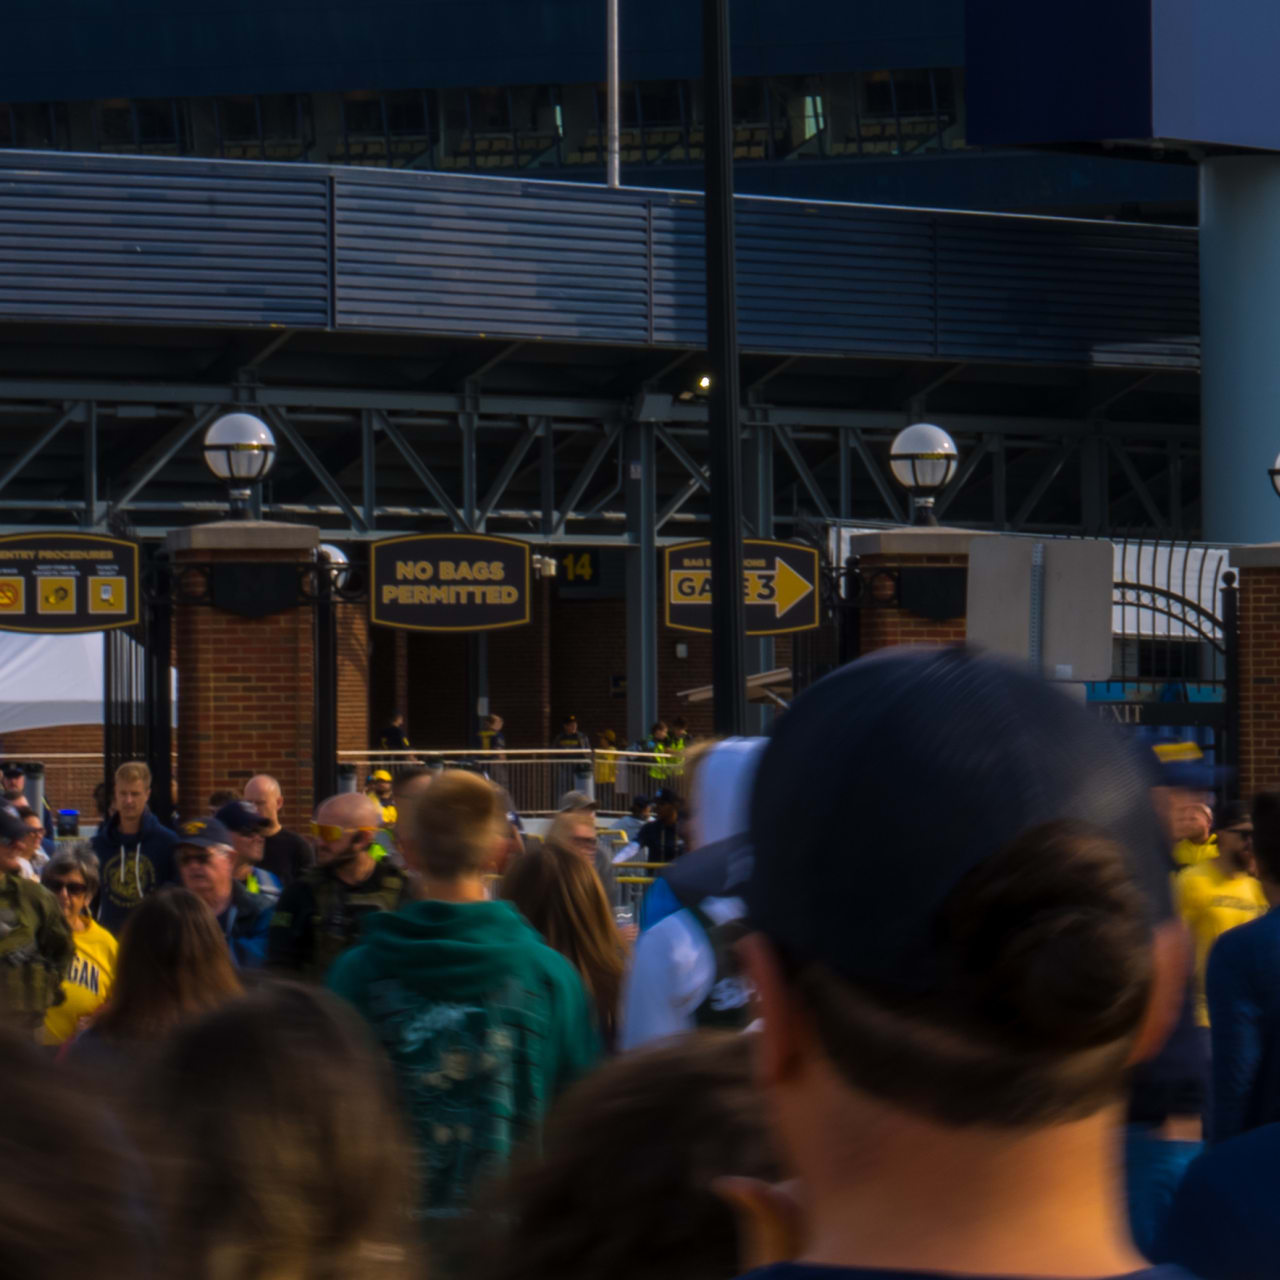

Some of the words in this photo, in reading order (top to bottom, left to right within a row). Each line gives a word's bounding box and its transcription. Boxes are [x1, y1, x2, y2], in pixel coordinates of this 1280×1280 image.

[396, 561, 434, 581] NO
[438, 561, 505, 581] BAGS
[563, 553, 593, 581] 14
[382, 585, 519, 604] PERMITTED
[677, 577, 750, 597] GAE
[756, 574, 776, 600] 3
